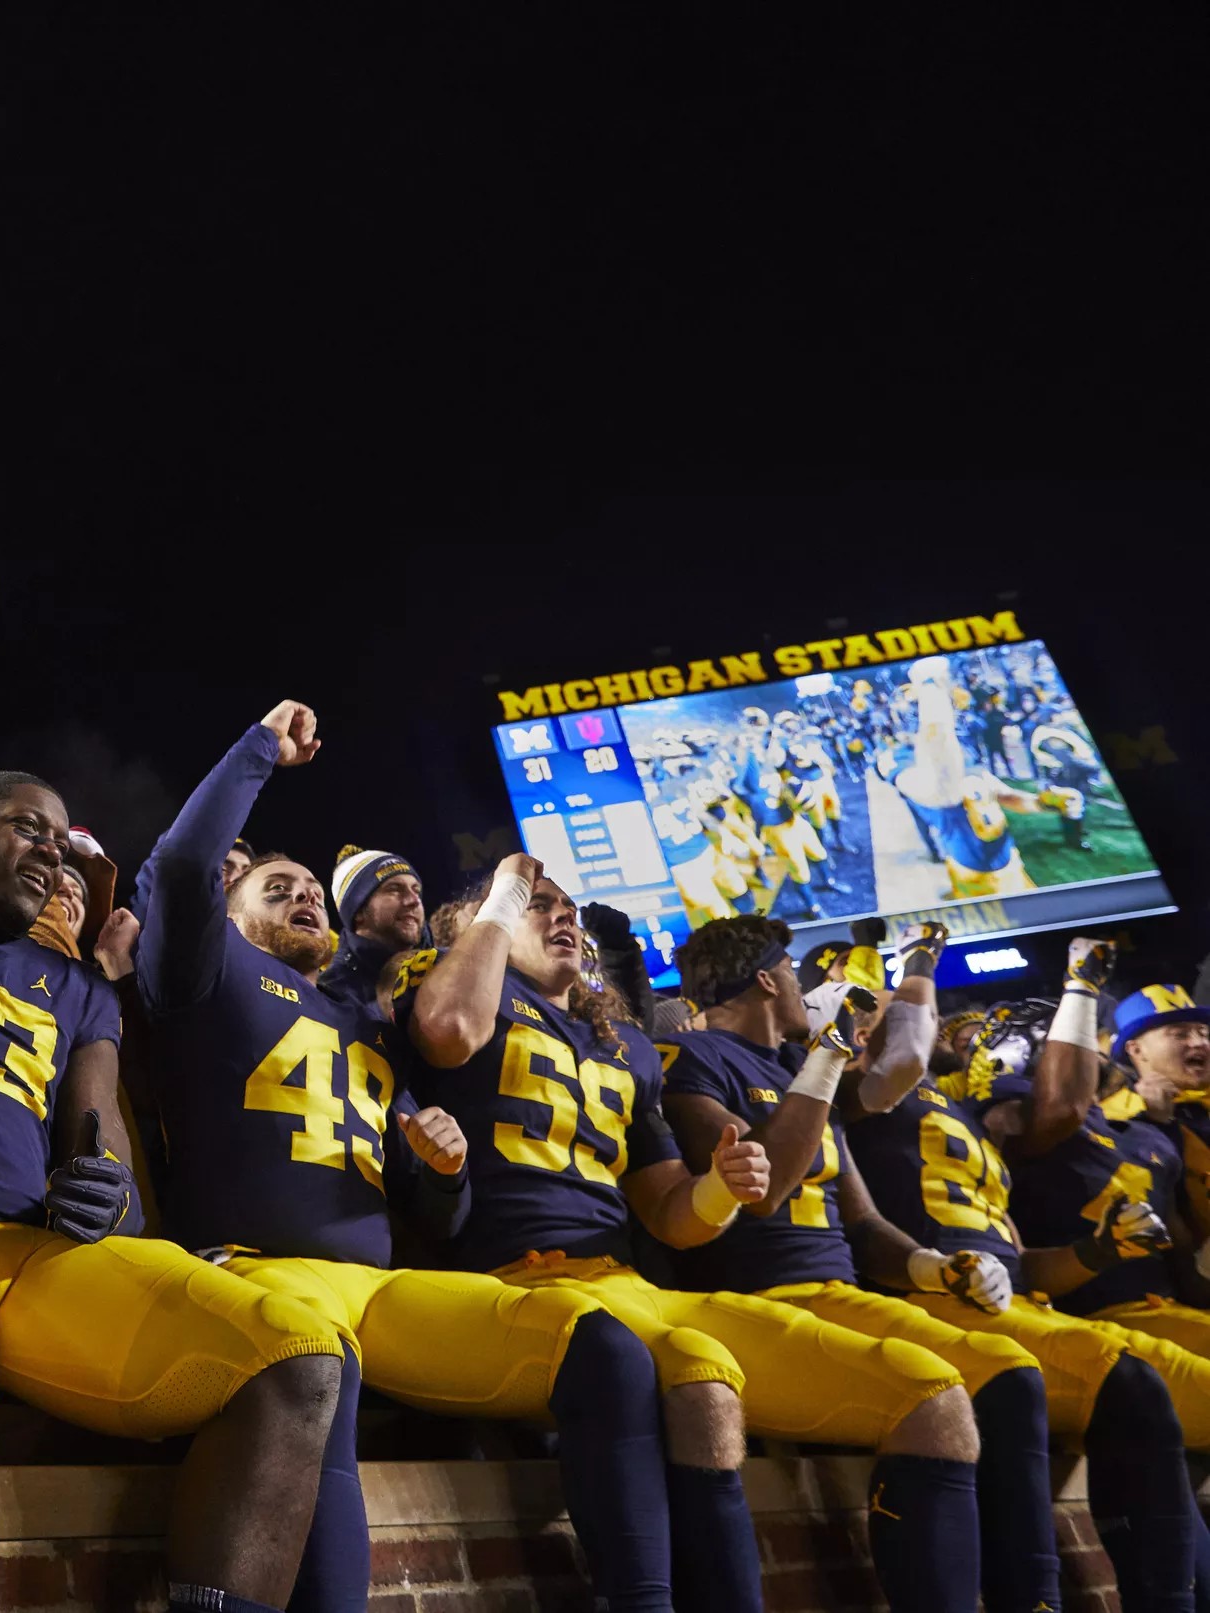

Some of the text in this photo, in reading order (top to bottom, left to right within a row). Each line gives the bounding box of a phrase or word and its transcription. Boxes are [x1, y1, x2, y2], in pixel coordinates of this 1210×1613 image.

[497, 611, 1025, 721] MICHIGAN STADIUM
[509, 724, 553, 754] M
[523, 757, 553, 783] 31
[583, 746, 619, 774] 20
[244, 1016, 395, 1197] 49
[493, 1022, 636, 1188] 59
